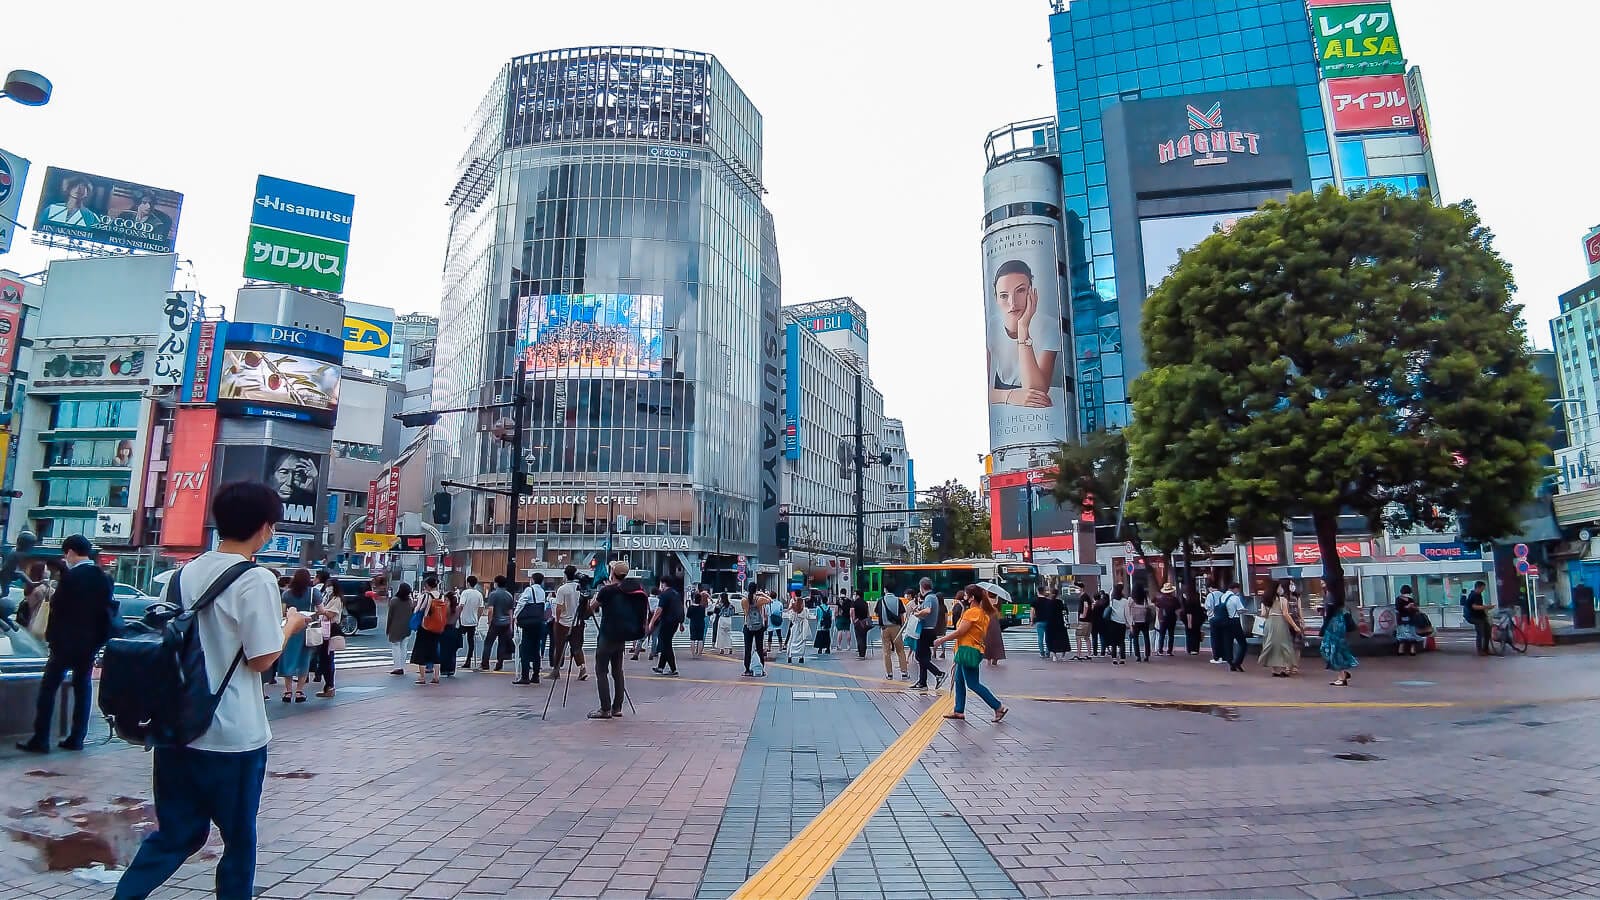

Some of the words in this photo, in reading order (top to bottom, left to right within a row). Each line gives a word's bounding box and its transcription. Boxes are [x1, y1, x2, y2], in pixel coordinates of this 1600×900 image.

[1319, 12, 1389, 36] レイク
[1323, 36, 1399, 59] ALSA
[1333, 90, 1406, 112] アイフル
[1391, 115, 1410, 126] 8F
[1158, 131, 1260, 164] MAGNET
[255, 194, 352, 225] Hisamitsu
[114, 217, 154, 233] GOOD
[253, 241, 340, 277] サロンパス
[155, 293, 189, 383] もんじゃ
[270, 327, 307, 344] DHC
[763, 307, 778, 512] TSUTAYA
[519, 495, 587, 505] STARBUCKS
[594, 495, 639, 505] COFFEE
[621, 535, 690, 550] TSUTAYA
[1425, 547, 1462, 557] PROMISE
